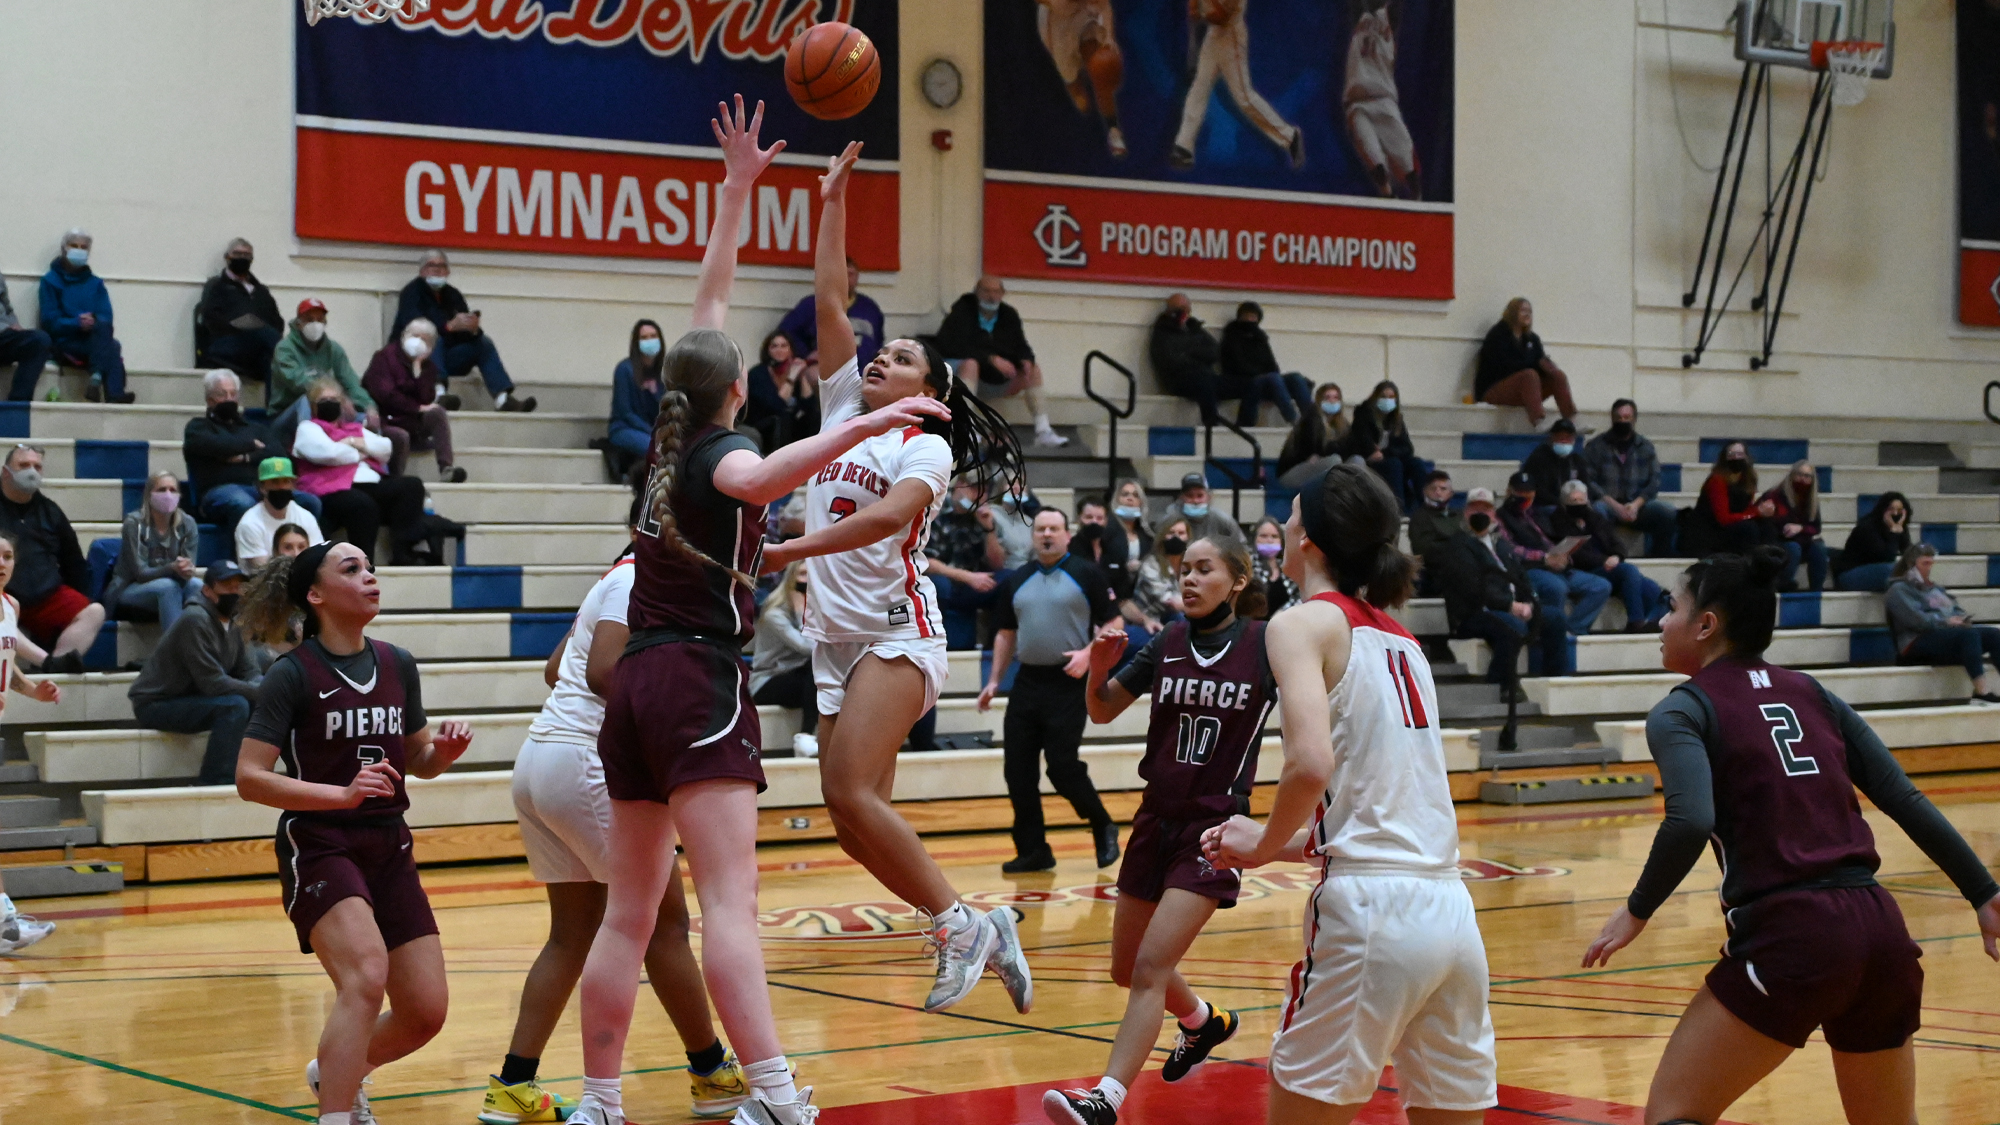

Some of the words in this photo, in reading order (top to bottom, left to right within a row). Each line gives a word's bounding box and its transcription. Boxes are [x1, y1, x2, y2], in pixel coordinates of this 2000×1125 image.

[1101, 221, 1229, 260] PROGRAM
[1236, 229, 1267, 262] OF
[1272, 231, 1417, 272] CHAMPIONS
[841, 461, 891, 499] DEVILS
[1159, 676, 1252, 711] PIERCE
[1385, 648, 1430, 729] 11
[1746, 669, 1773, 689] N
[325, 706, 403, 740] PIERCE
[1176, 712, 1222, 766] 10
[1758, 703, 1820, 777] 2
